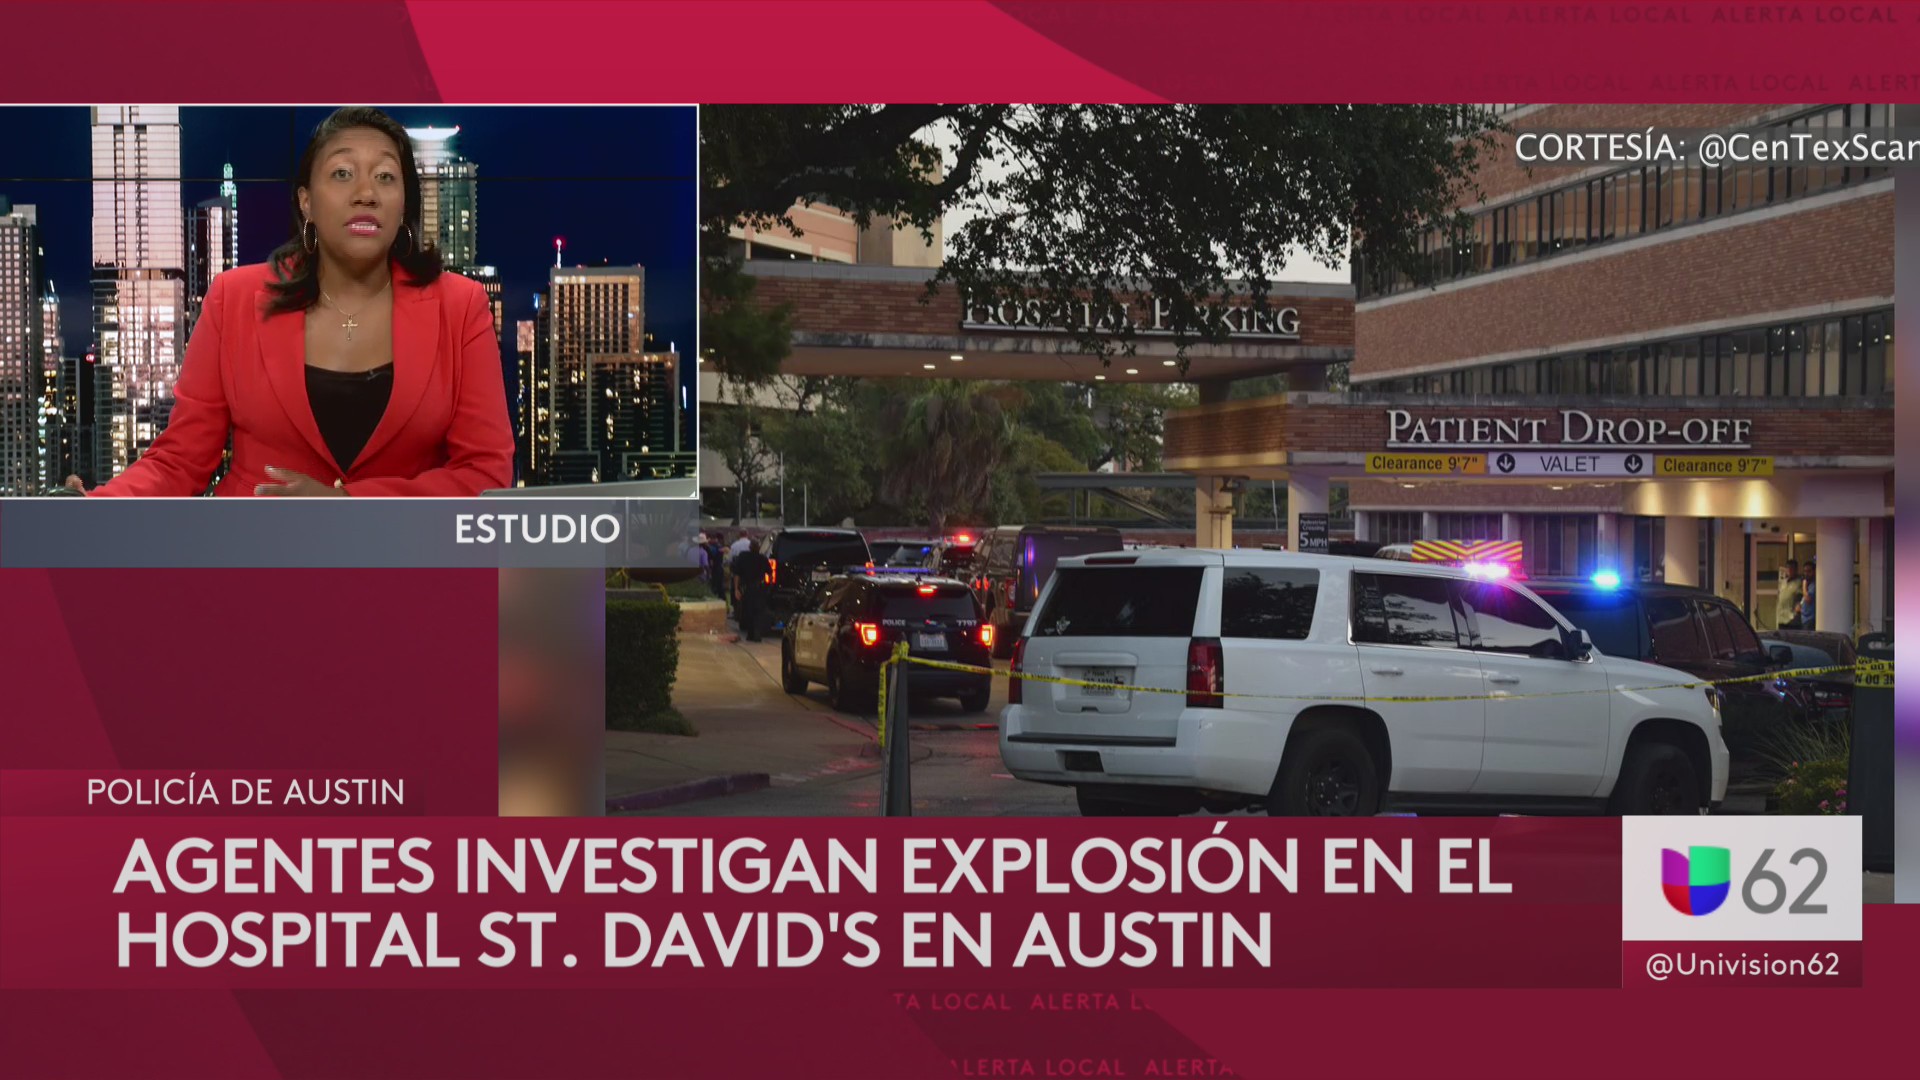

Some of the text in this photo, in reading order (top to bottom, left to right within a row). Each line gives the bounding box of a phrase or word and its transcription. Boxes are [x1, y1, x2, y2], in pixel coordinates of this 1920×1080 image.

[1152, 297, 1300, 334] PRKING
[1386, 409, 1752, 443] PATIENT DROP-OFF
[1372, 456, 1442, 471] Clearance
[1540, 455, 1600, 472] VALET
[1664, 458, 1732, 473] Clearance
[1300, 532, 1328, 547] 5 MPH
[882, 619, 906, 627] POLICE
